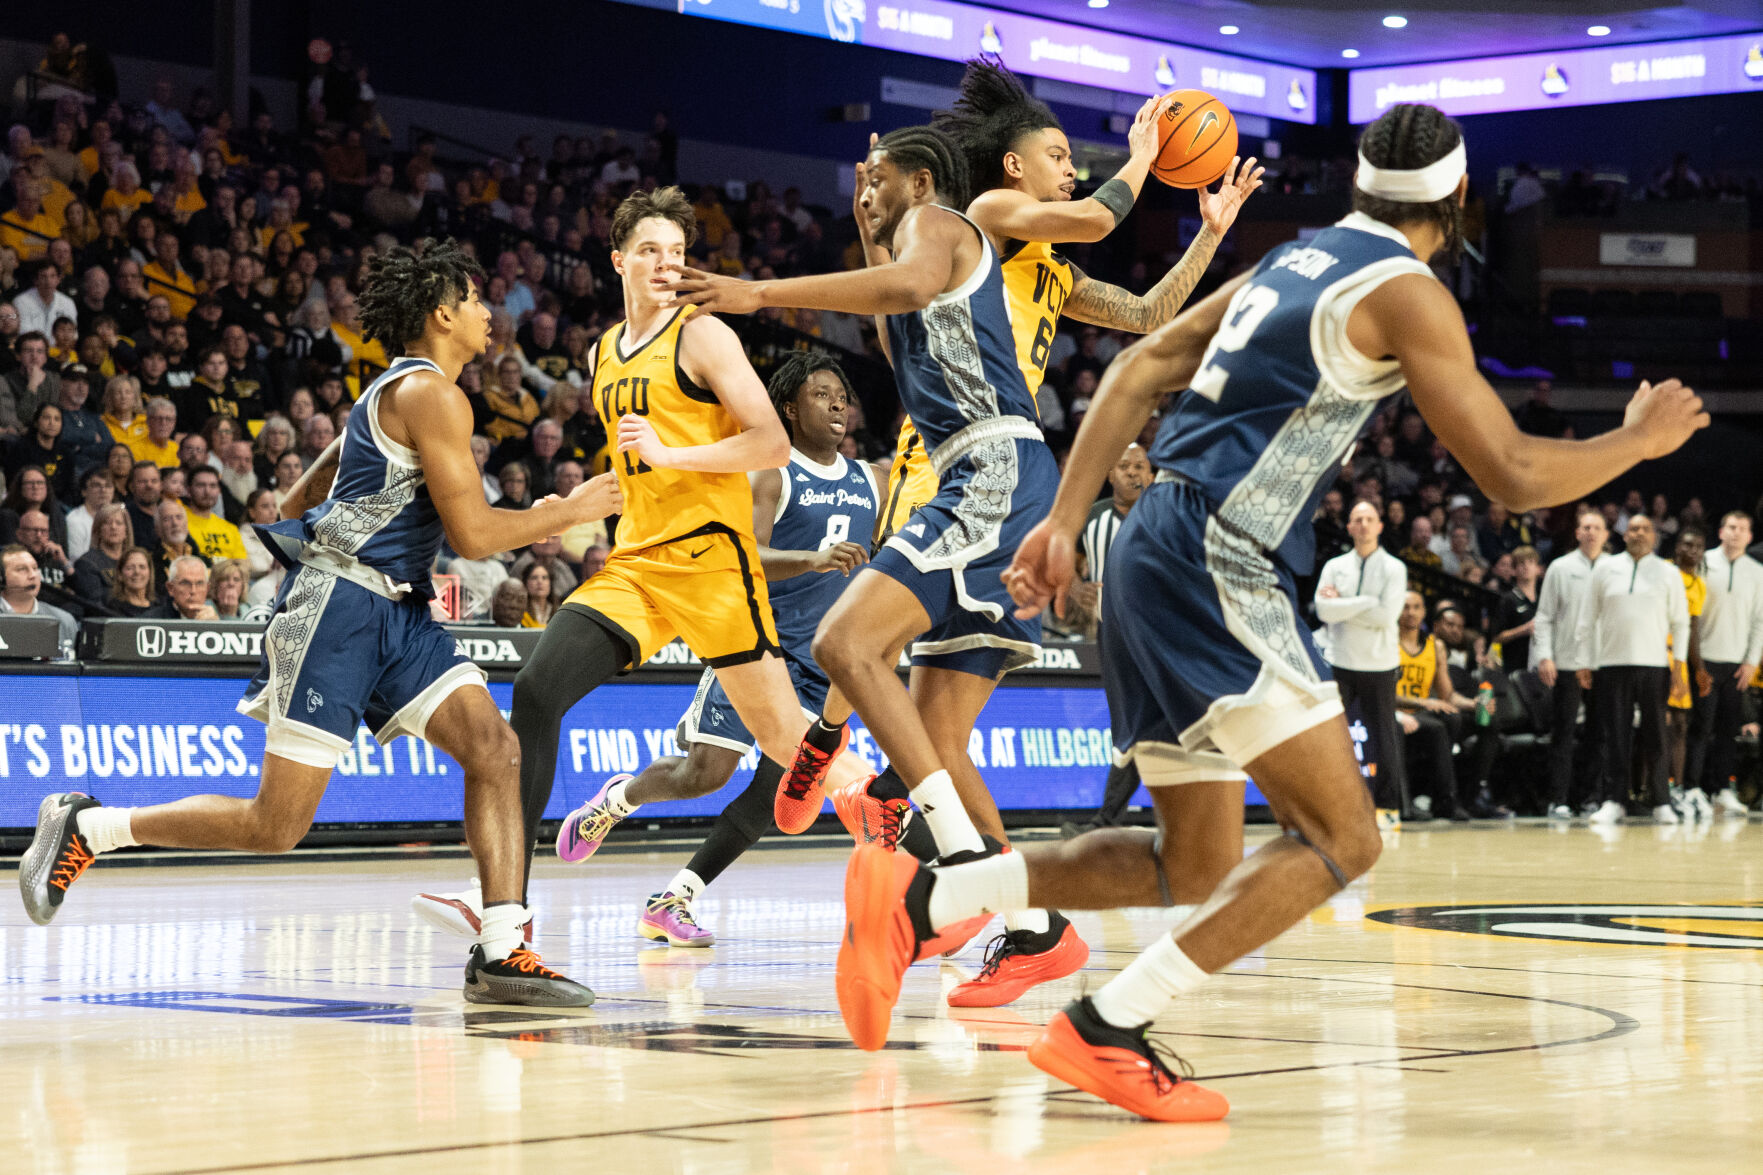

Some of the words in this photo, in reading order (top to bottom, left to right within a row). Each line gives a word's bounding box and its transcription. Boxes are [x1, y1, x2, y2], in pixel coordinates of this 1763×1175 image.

[1030, 316, 1053, 371] 6
[602, 377, 650, 424] VCU
[799, 488, 836, 506] Saint
[168, 631, 263, 656] HON
[60, 724, 259, 777] BUSINESS.
[569, 728, 639, 773] FIND
[991, 727, 1016, 768] AT
